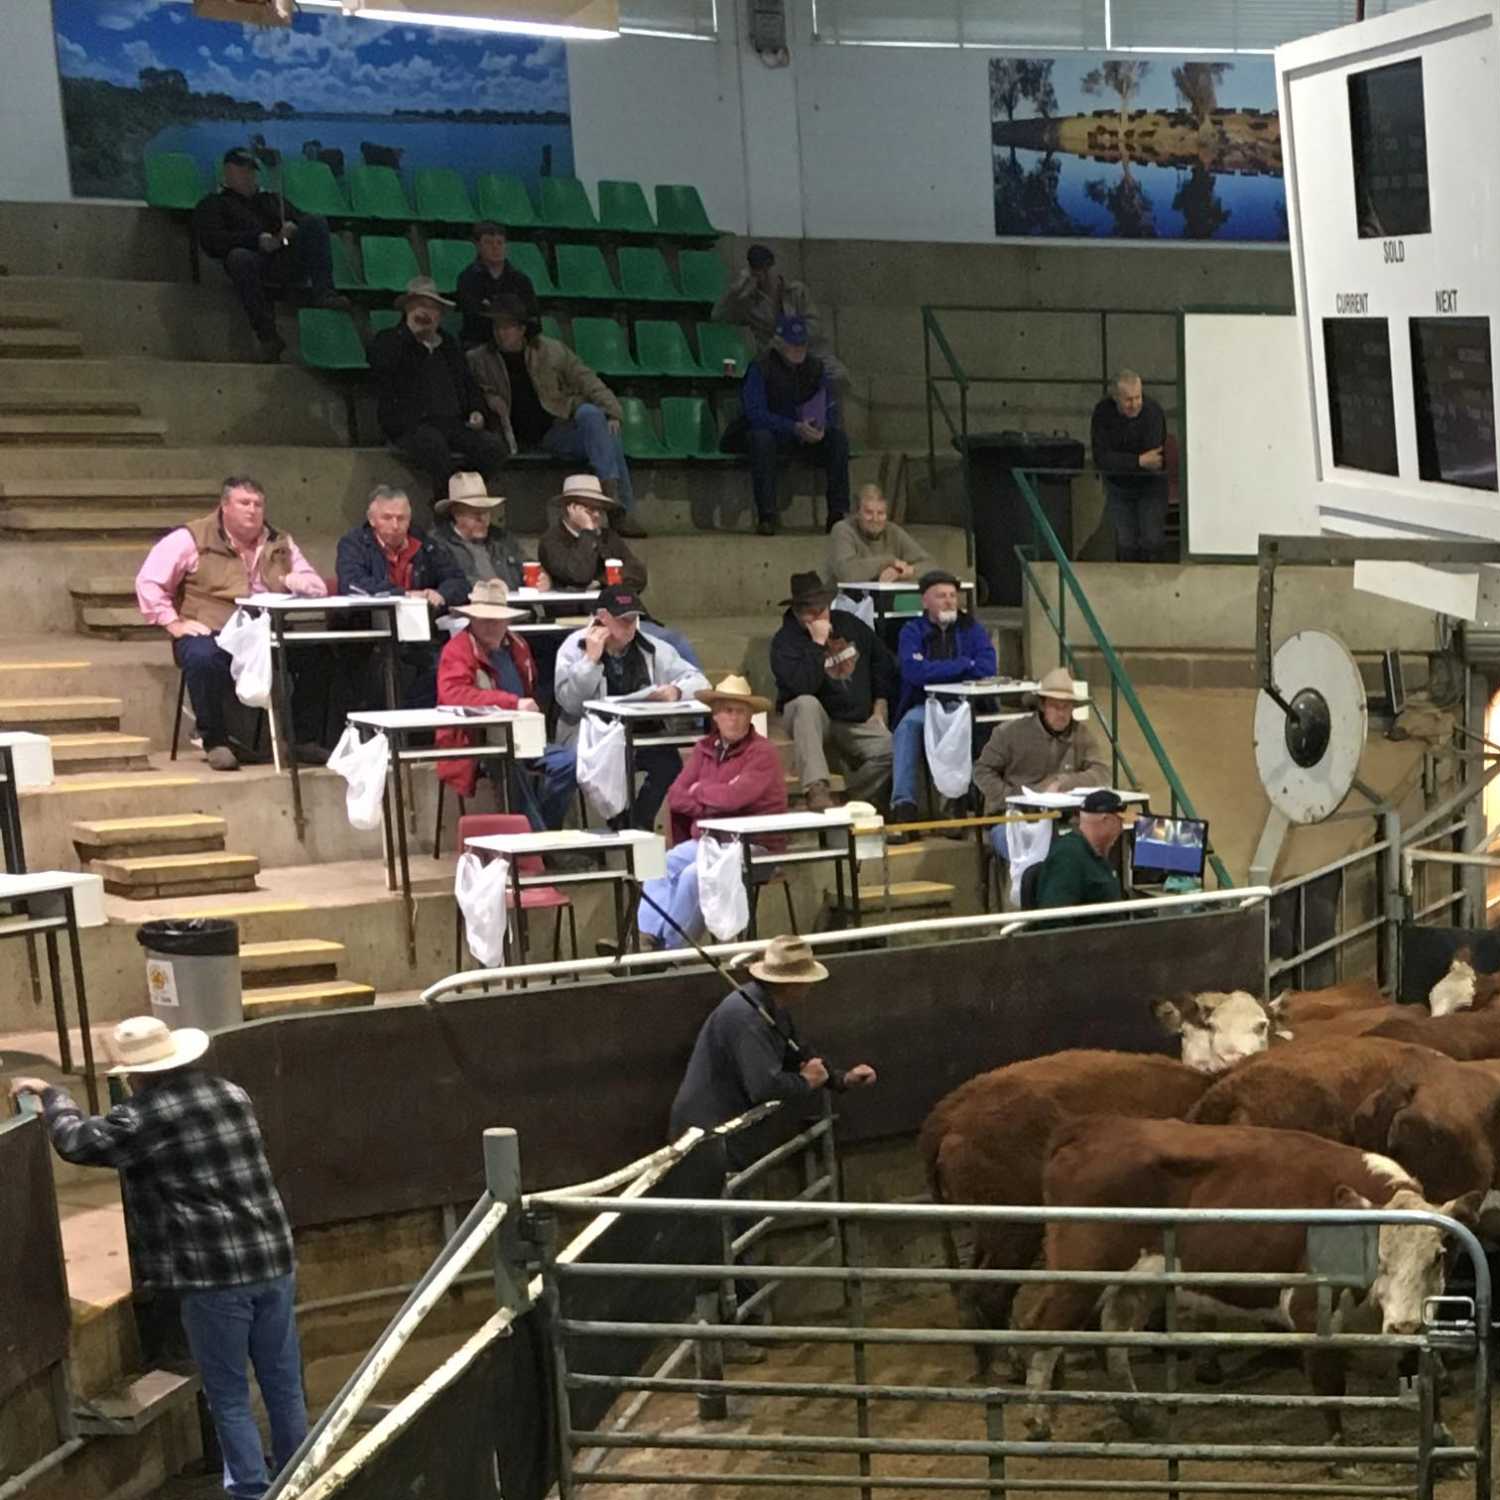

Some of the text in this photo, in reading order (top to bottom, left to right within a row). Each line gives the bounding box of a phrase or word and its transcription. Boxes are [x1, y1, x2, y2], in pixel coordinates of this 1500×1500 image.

[1383, 240, 1405, 264] SOLD
[1336, 292, 1369, 314] CURRENT
[1435, 290, 1458, 313] NEXT
